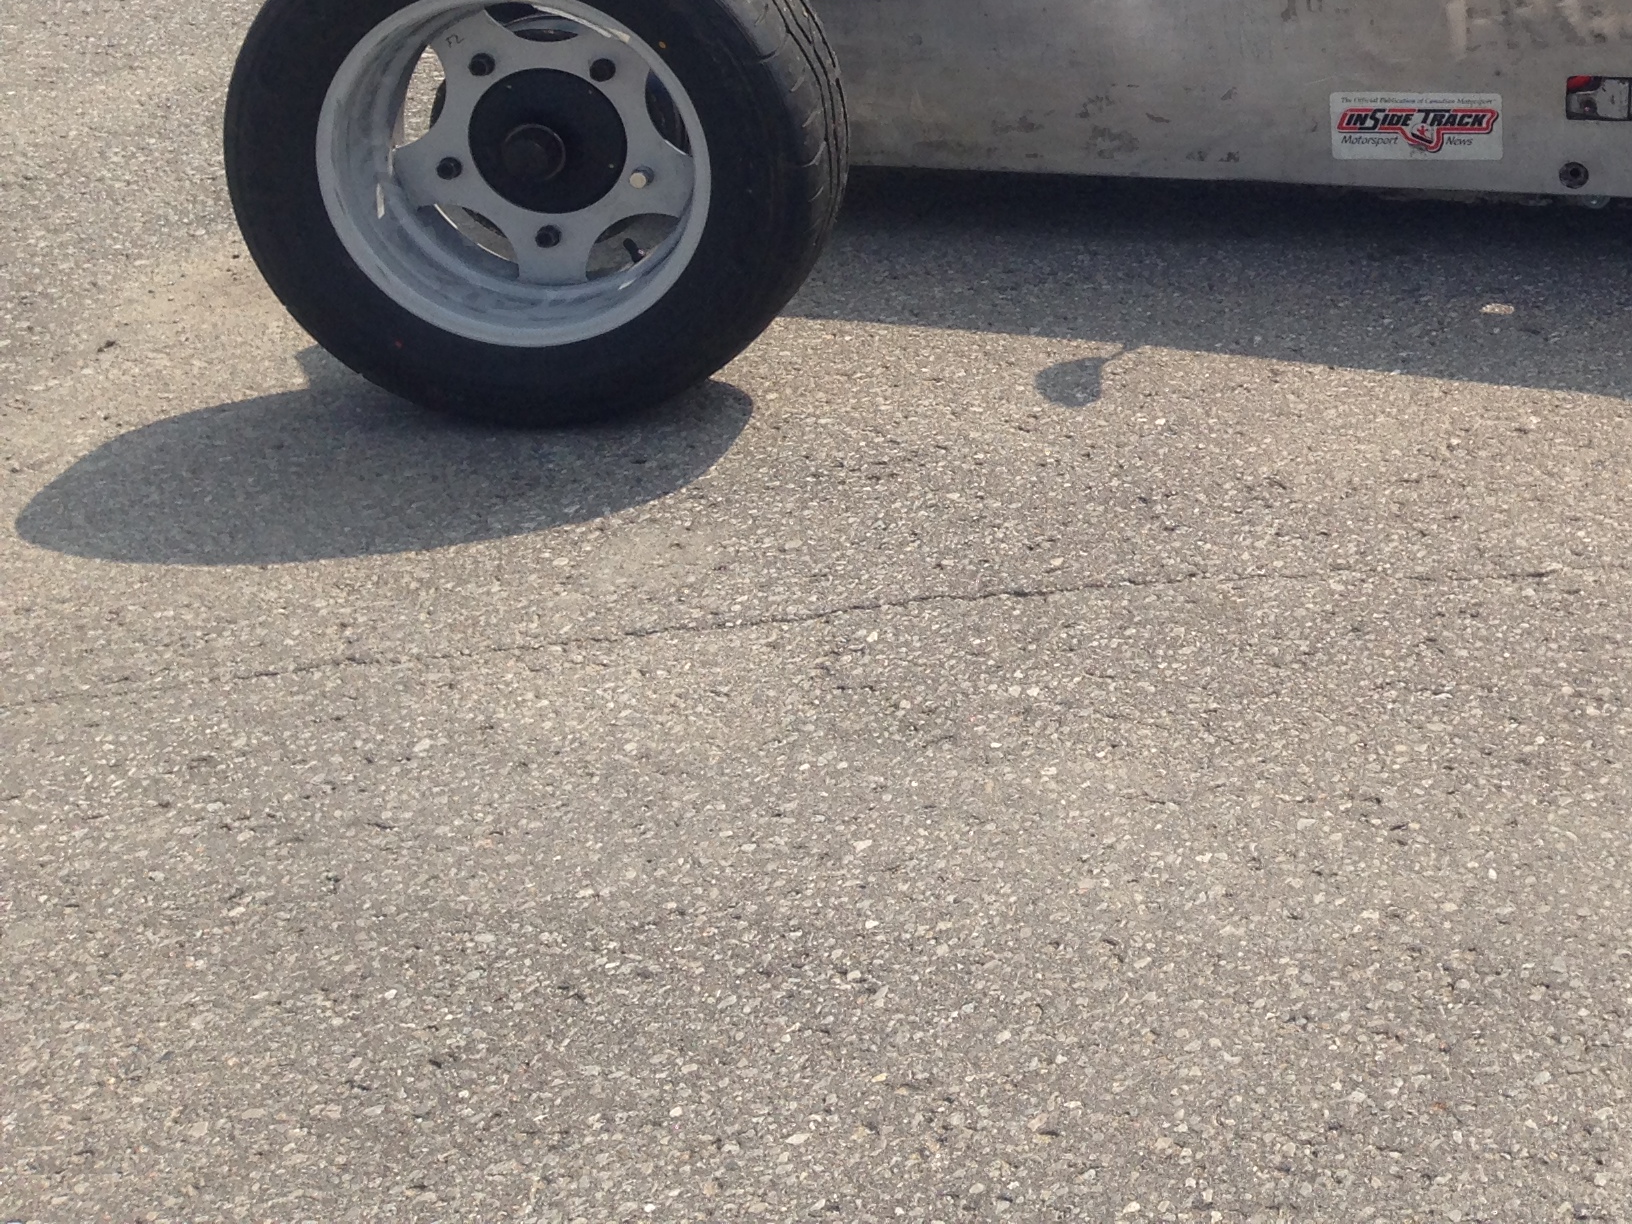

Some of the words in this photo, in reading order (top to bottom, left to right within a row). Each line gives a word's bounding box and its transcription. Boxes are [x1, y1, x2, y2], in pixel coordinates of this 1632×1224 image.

[1416, 109, 1487, 127] TRACK
[1341, 135, 1398, 146] Motorsport
[1445, 136, 1473, 146] News
